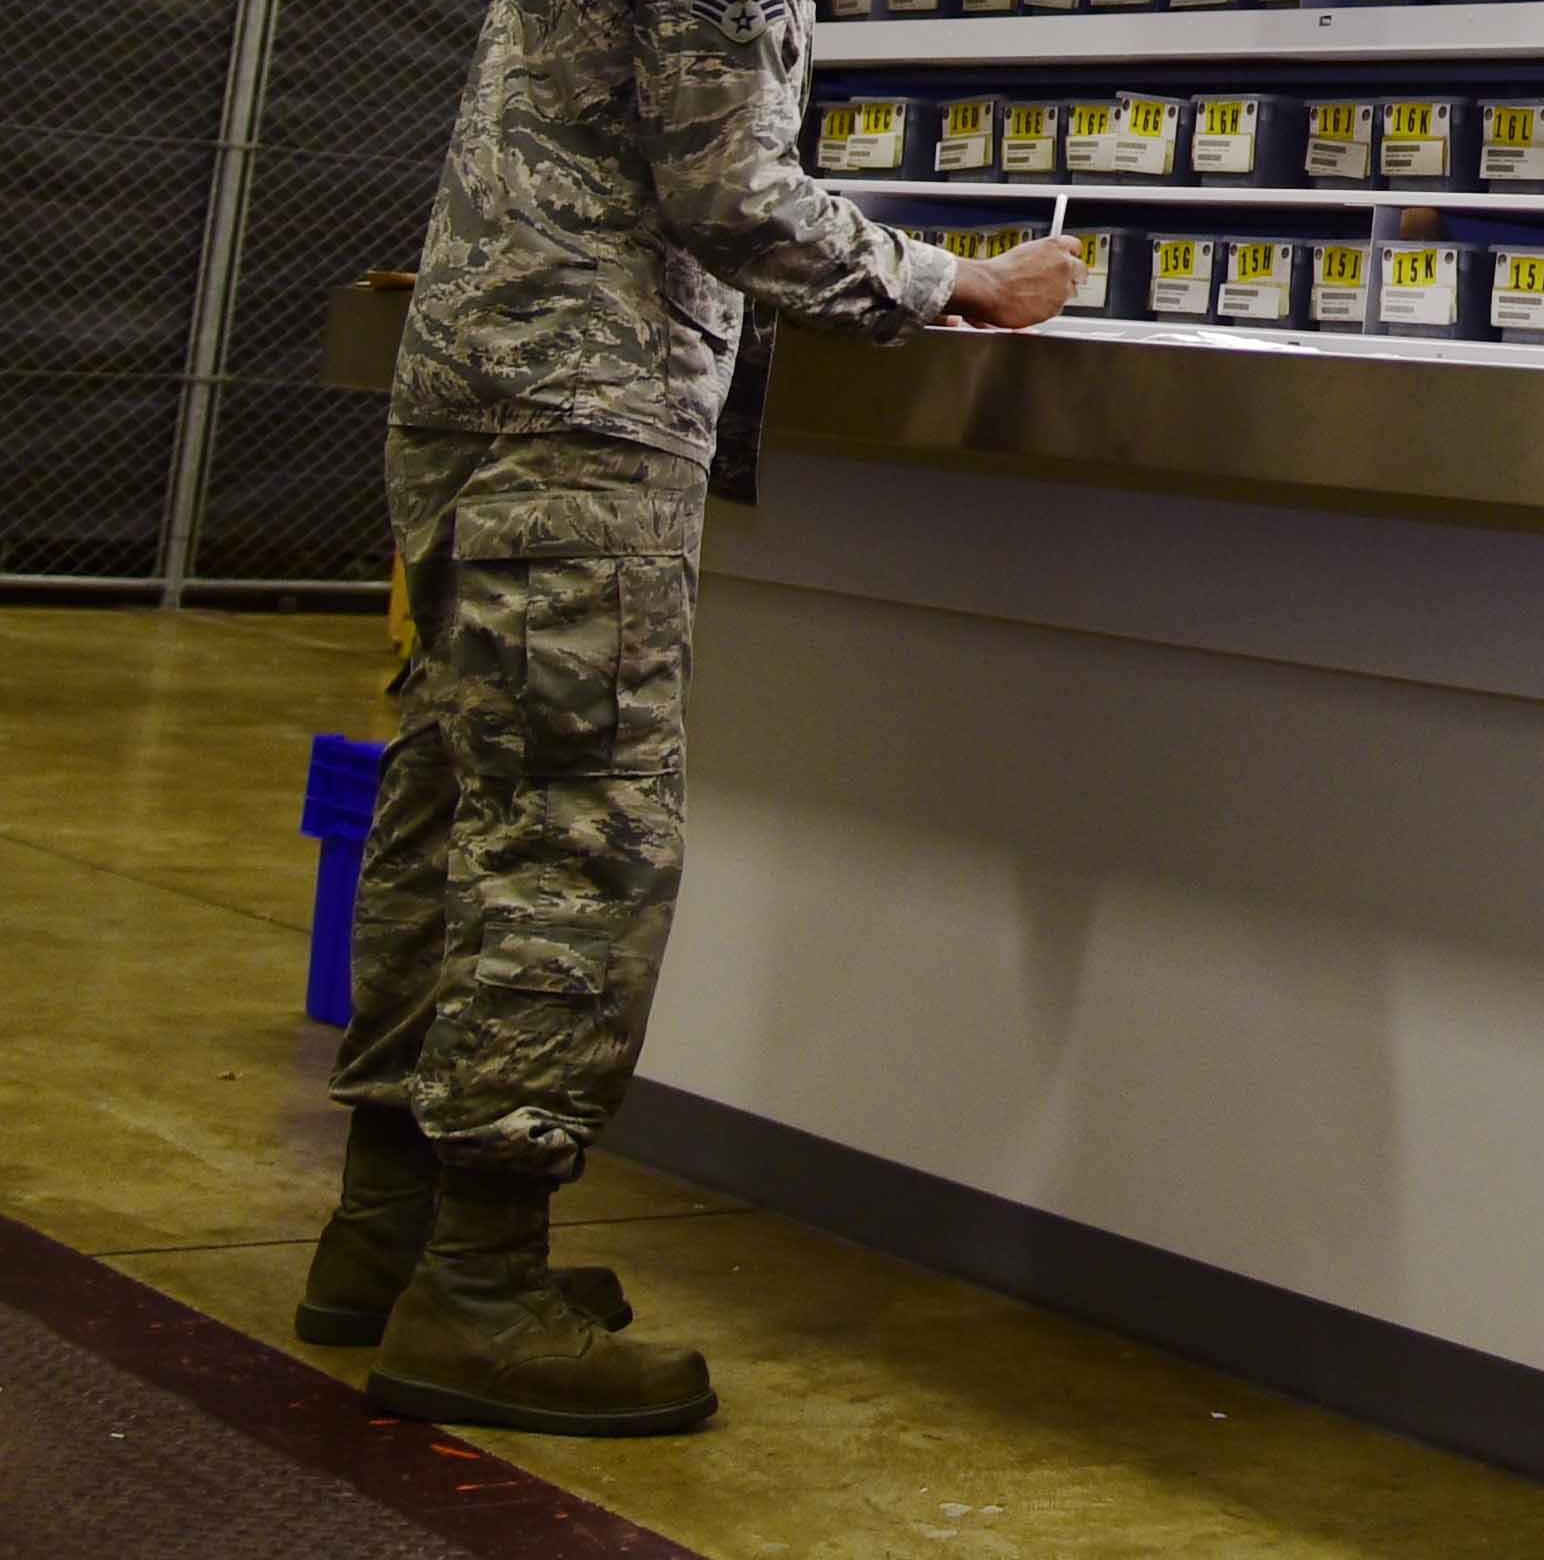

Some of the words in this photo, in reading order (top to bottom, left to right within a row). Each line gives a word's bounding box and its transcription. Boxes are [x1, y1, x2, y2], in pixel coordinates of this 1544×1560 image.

[1015, 111, 1042, 135] 16E
[1132, 105, 1160, 132] 16G
[1208, 108, 1240, 135] 16H
[1321, 107, 1351, 133] 16J
[1394, 107, 1430, 134] 16K
[1495, 113, 1530, 141] 16L
[1163, 246, 1191, 273] 15G
[1240, 246, 1272, 275] 15H
[1326, 249, 1360, 280] 15J
[1396, 253, 1434, 284] 15K
